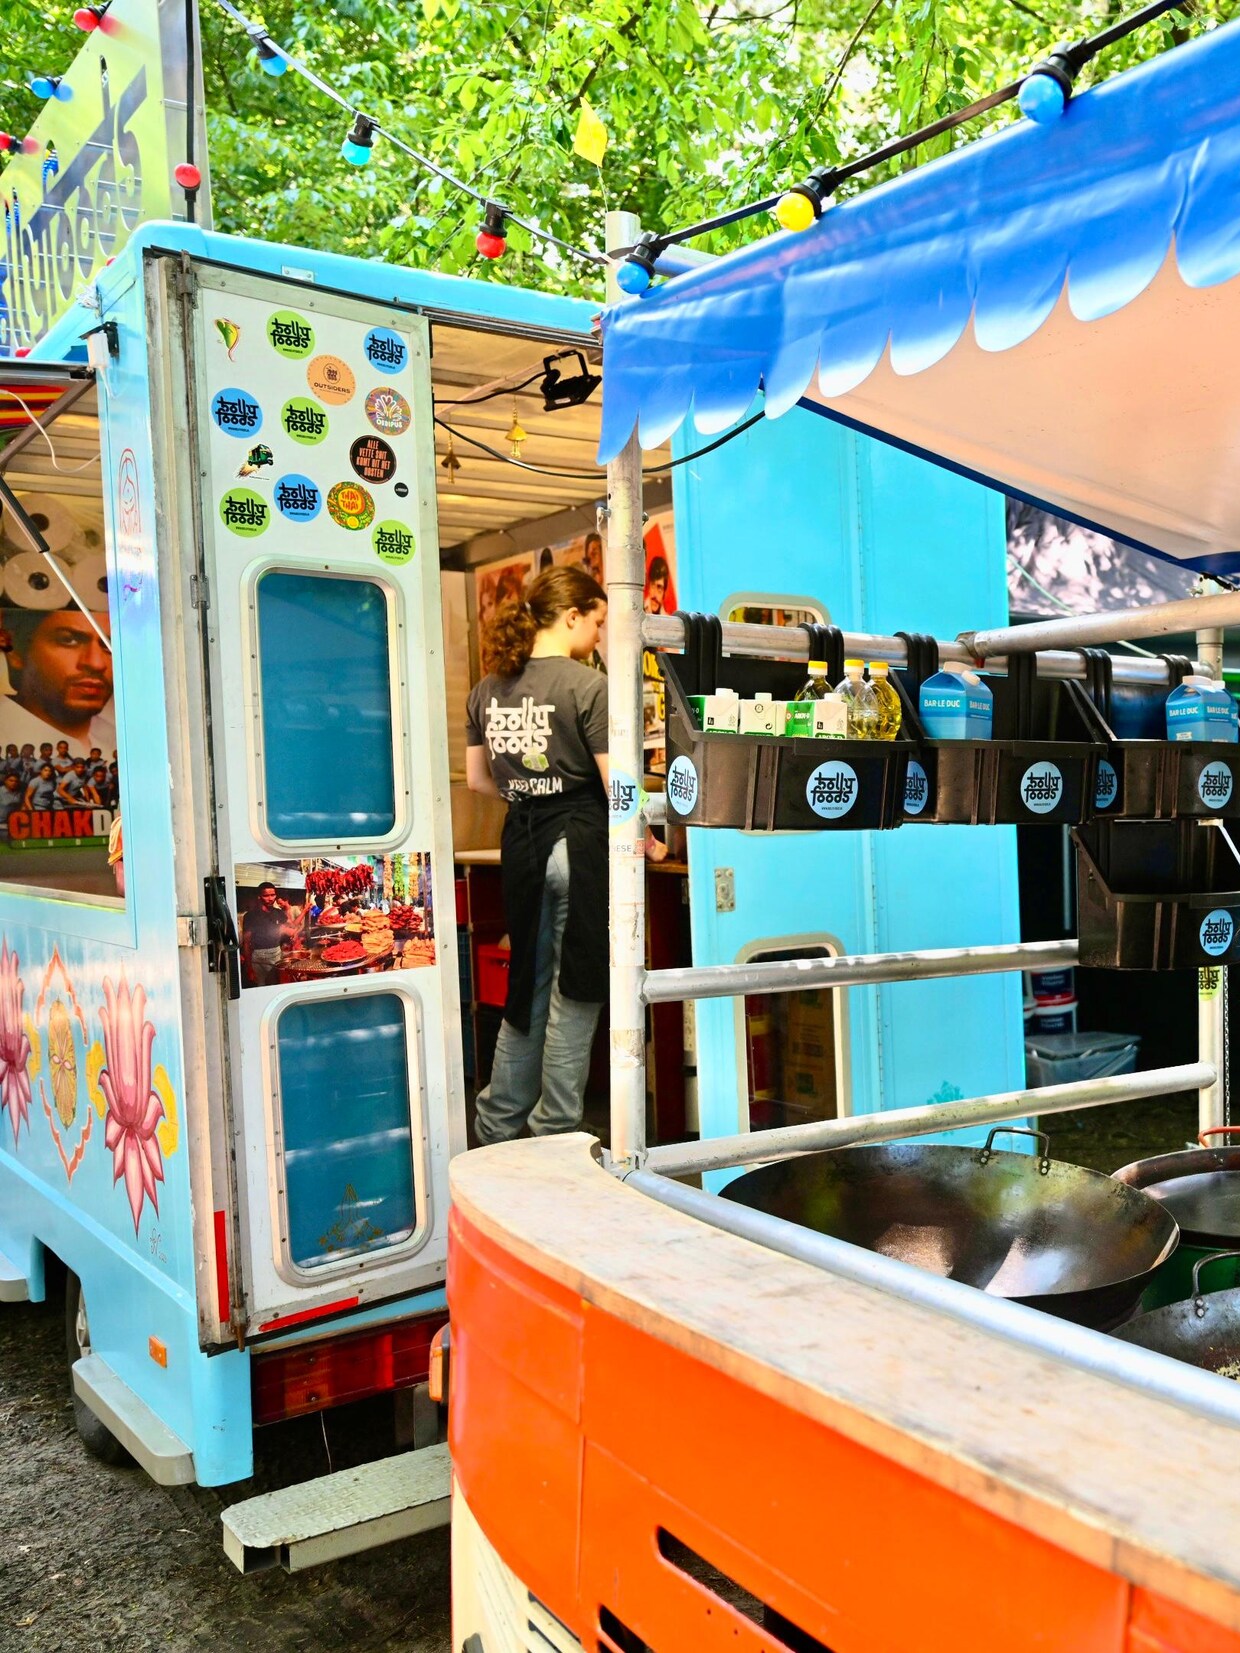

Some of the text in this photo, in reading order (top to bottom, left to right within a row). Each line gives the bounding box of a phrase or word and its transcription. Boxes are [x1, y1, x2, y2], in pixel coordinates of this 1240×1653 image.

[314, 382, 350, 394] OUTSIDERS
[485, 697, 555, 734] bolly
[485, 723, 552, 760] foods
[530, 776, 563, 795] CALM
[814, 772, 856, 791] bolly
[1027, 772, 1060, 790] bolly
[1204, 770, 1231, 787] bolly
[810, 785, 853, 806] foods
[1024, 784, 1059, 803] foods
[1201, 781, 1229, 798] foods
